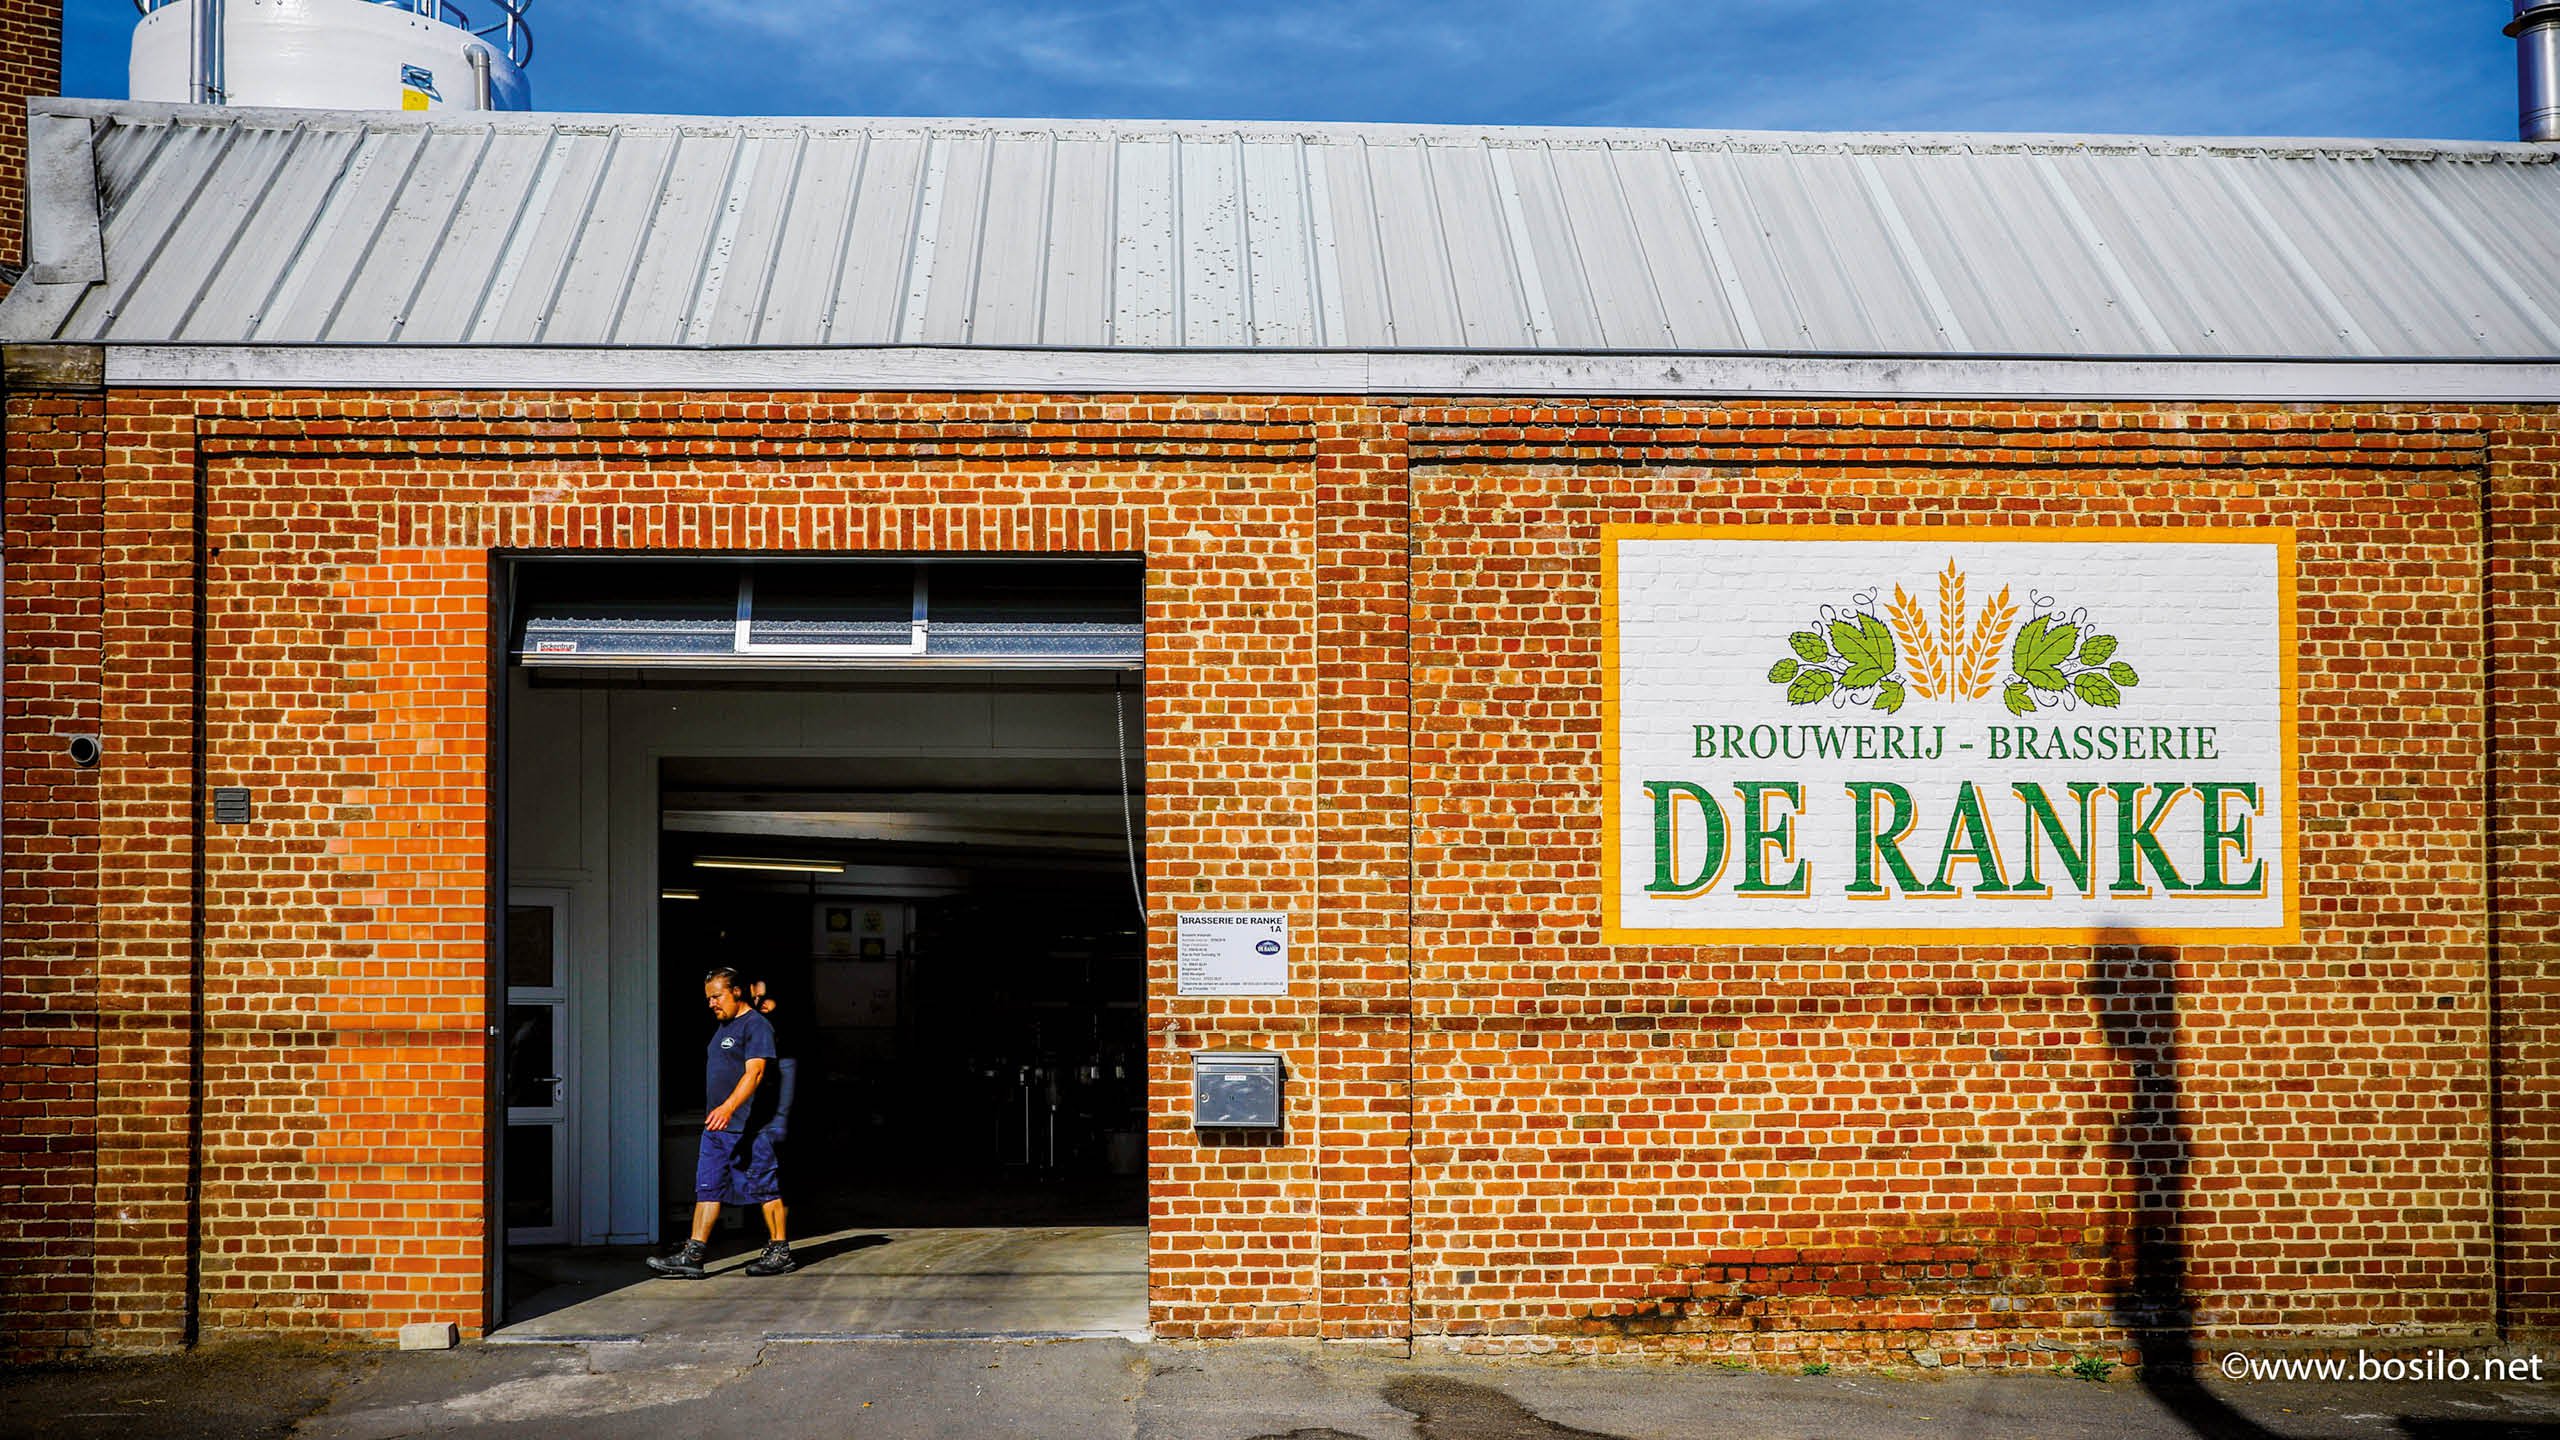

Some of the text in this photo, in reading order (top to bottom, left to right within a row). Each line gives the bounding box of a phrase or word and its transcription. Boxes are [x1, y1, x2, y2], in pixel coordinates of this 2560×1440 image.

[1691, 724, 1945, 761] BROUWERIJ
[1986, 724, 2220, 761] BRASSERIE
[1642, 780, 2269, 900] DE RANKE
